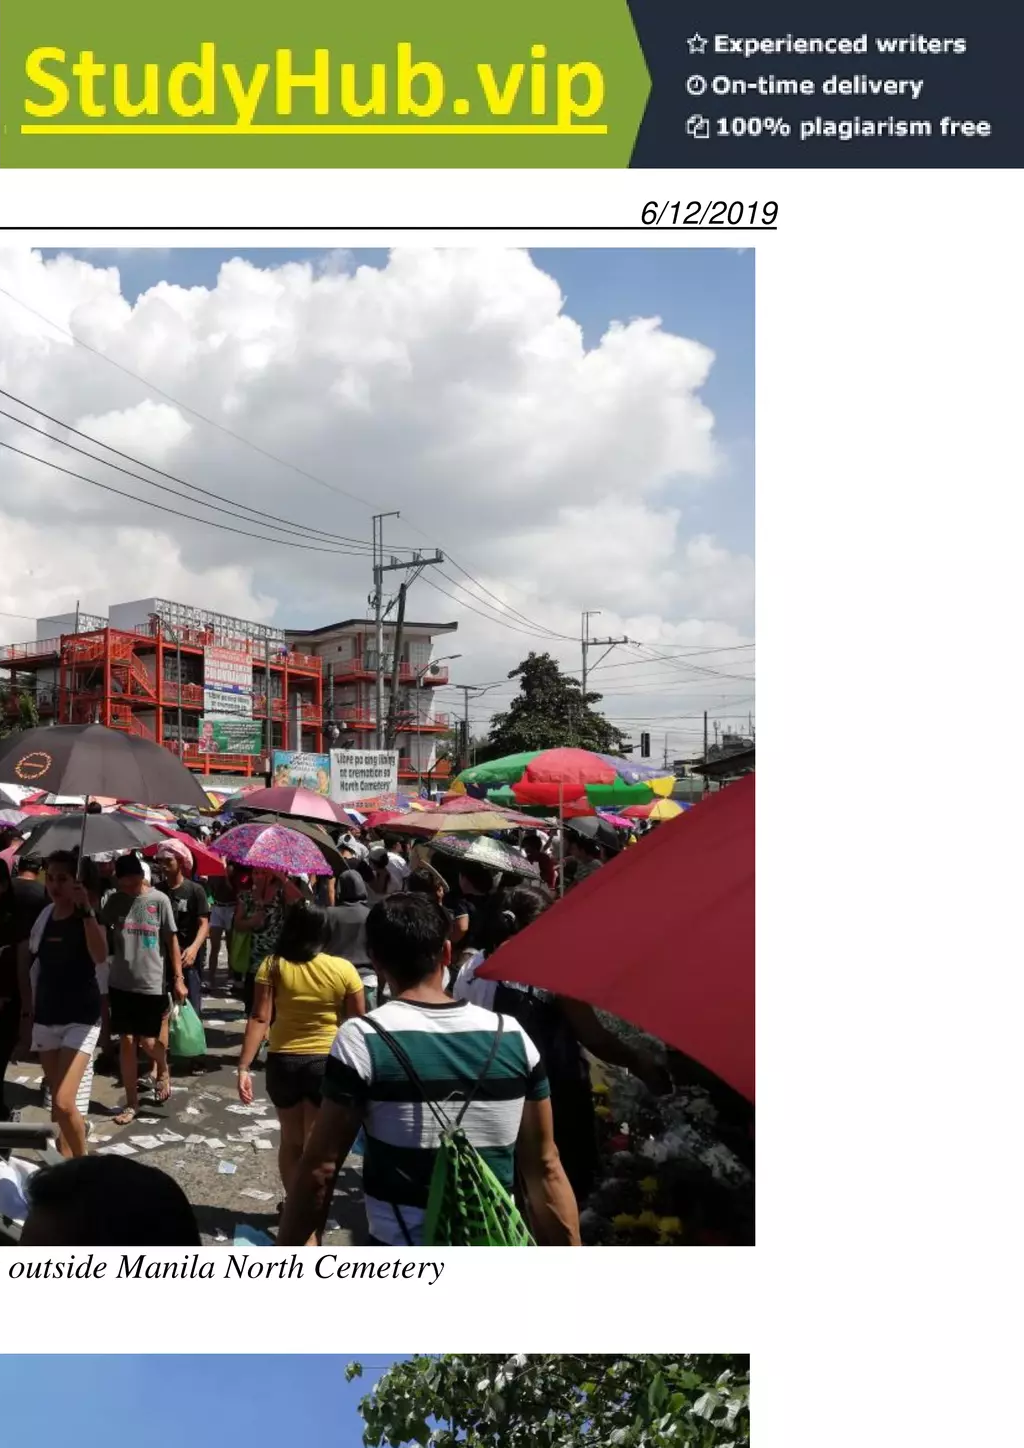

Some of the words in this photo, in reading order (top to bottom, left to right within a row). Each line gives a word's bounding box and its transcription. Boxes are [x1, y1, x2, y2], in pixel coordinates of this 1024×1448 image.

[641, 200, 779, 225] 6/12/2019
[8, 1253, 108, 1279] outside
[115, 1253, 215, 1279] Manila
[223, 1253, 304, 1279] North
[314, 1254, 445, 1286] Cemetery
